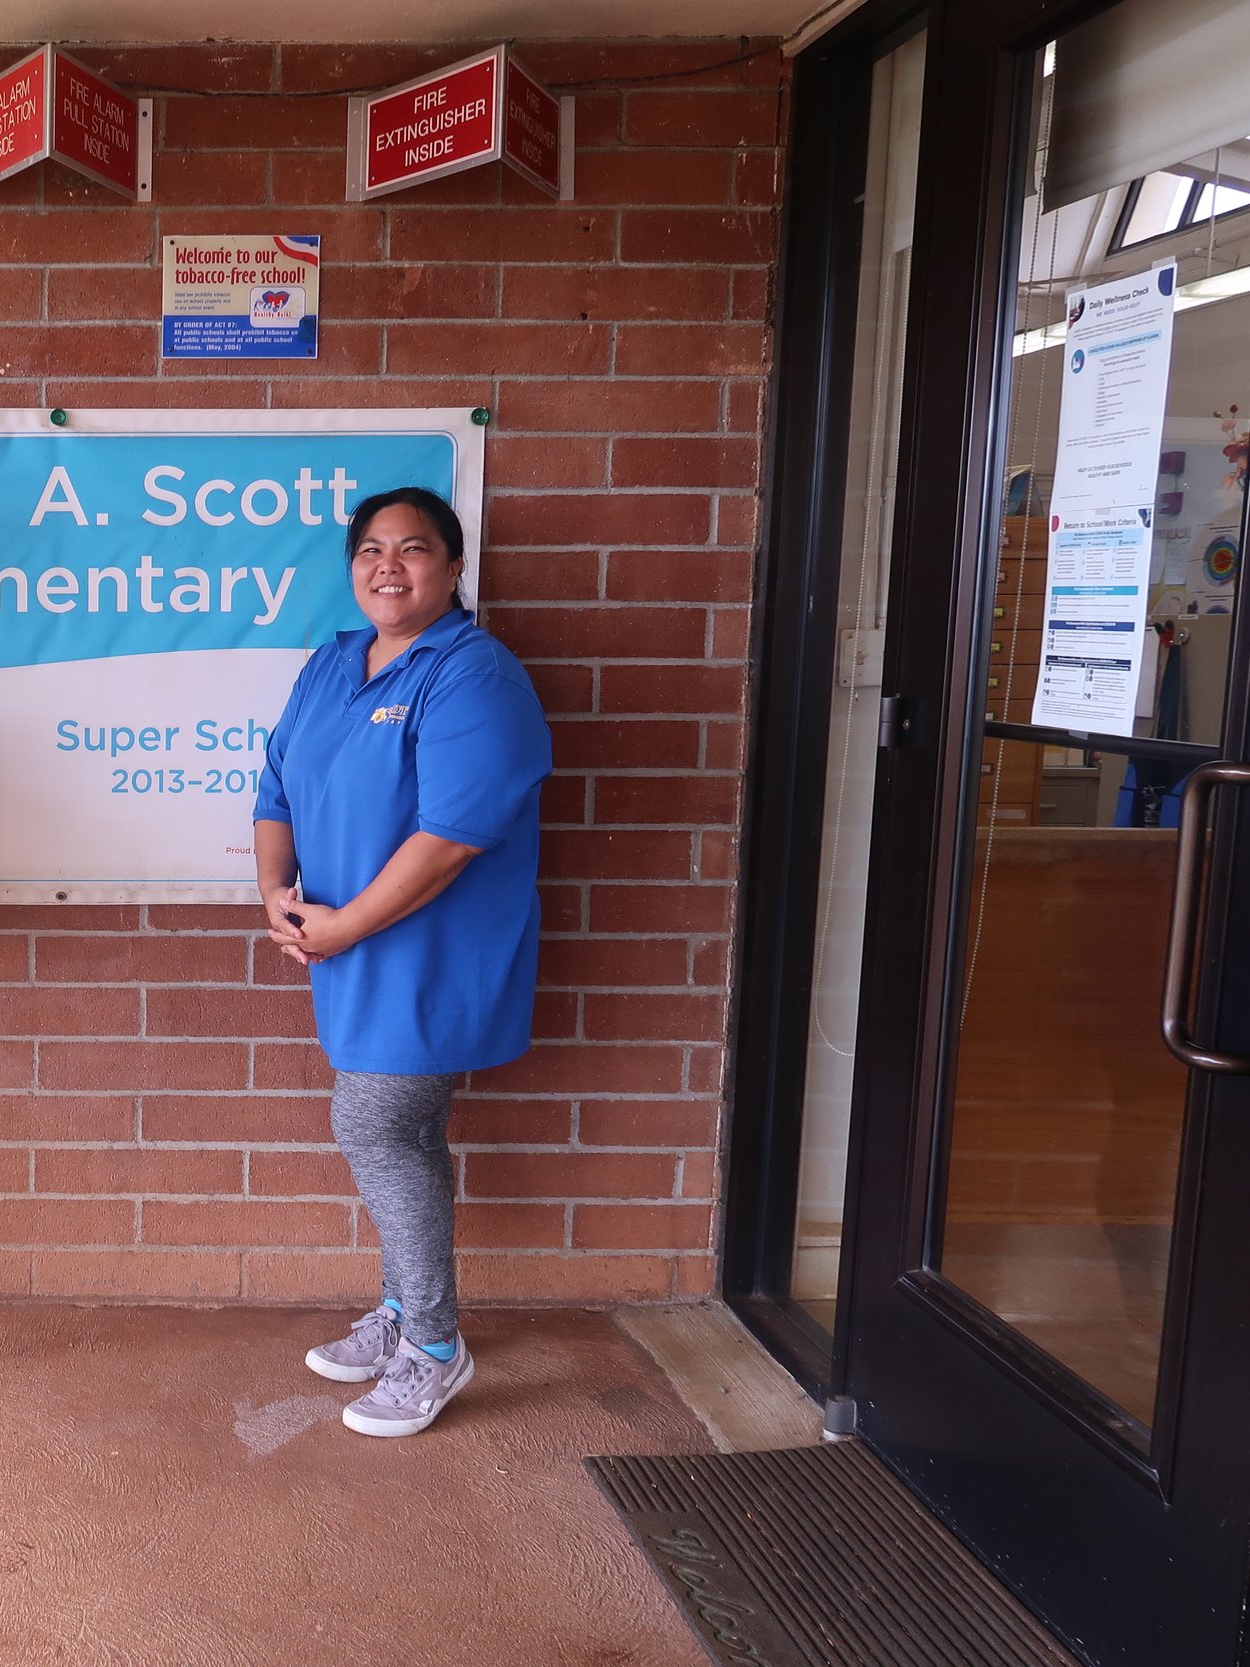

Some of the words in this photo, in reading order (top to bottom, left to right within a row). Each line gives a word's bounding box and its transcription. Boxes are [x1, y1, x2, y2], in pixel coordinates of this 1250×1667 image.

[70, 78, 90, 106] FIRE
[93, 93, 124, 126] ALARM
[414, 87, 447, 114] FIRE
[63, 98, 88, 129] PULL
[91, 114, 130, 152] STATION
[376, 99, 486, 152] EXTINGUISHER
[83, 133, 110, 164] INSIDE
[405, 135, 454, 167] INSIDE
[175, 247, 232, 264] Welcome
[236, 249, 250, 264] to
[254, 250, 278, 264] our
[175, 267, 256, 285] tobacco-free
[261, 267, 306, 284] school!
[182, 329, 201, 337] public
[242, 329, 265, 337] prohibit
[206, 344, 223, 352] (May,
[224, 344, 242, 352] 2004)
[29, 465, 111, 527] A.
[141, 464, 358, 528] Scott
[55, 718, 180, 758] Super
[195, 718, 269, 751] Sch
[225, 846, 250, 854] Proud
